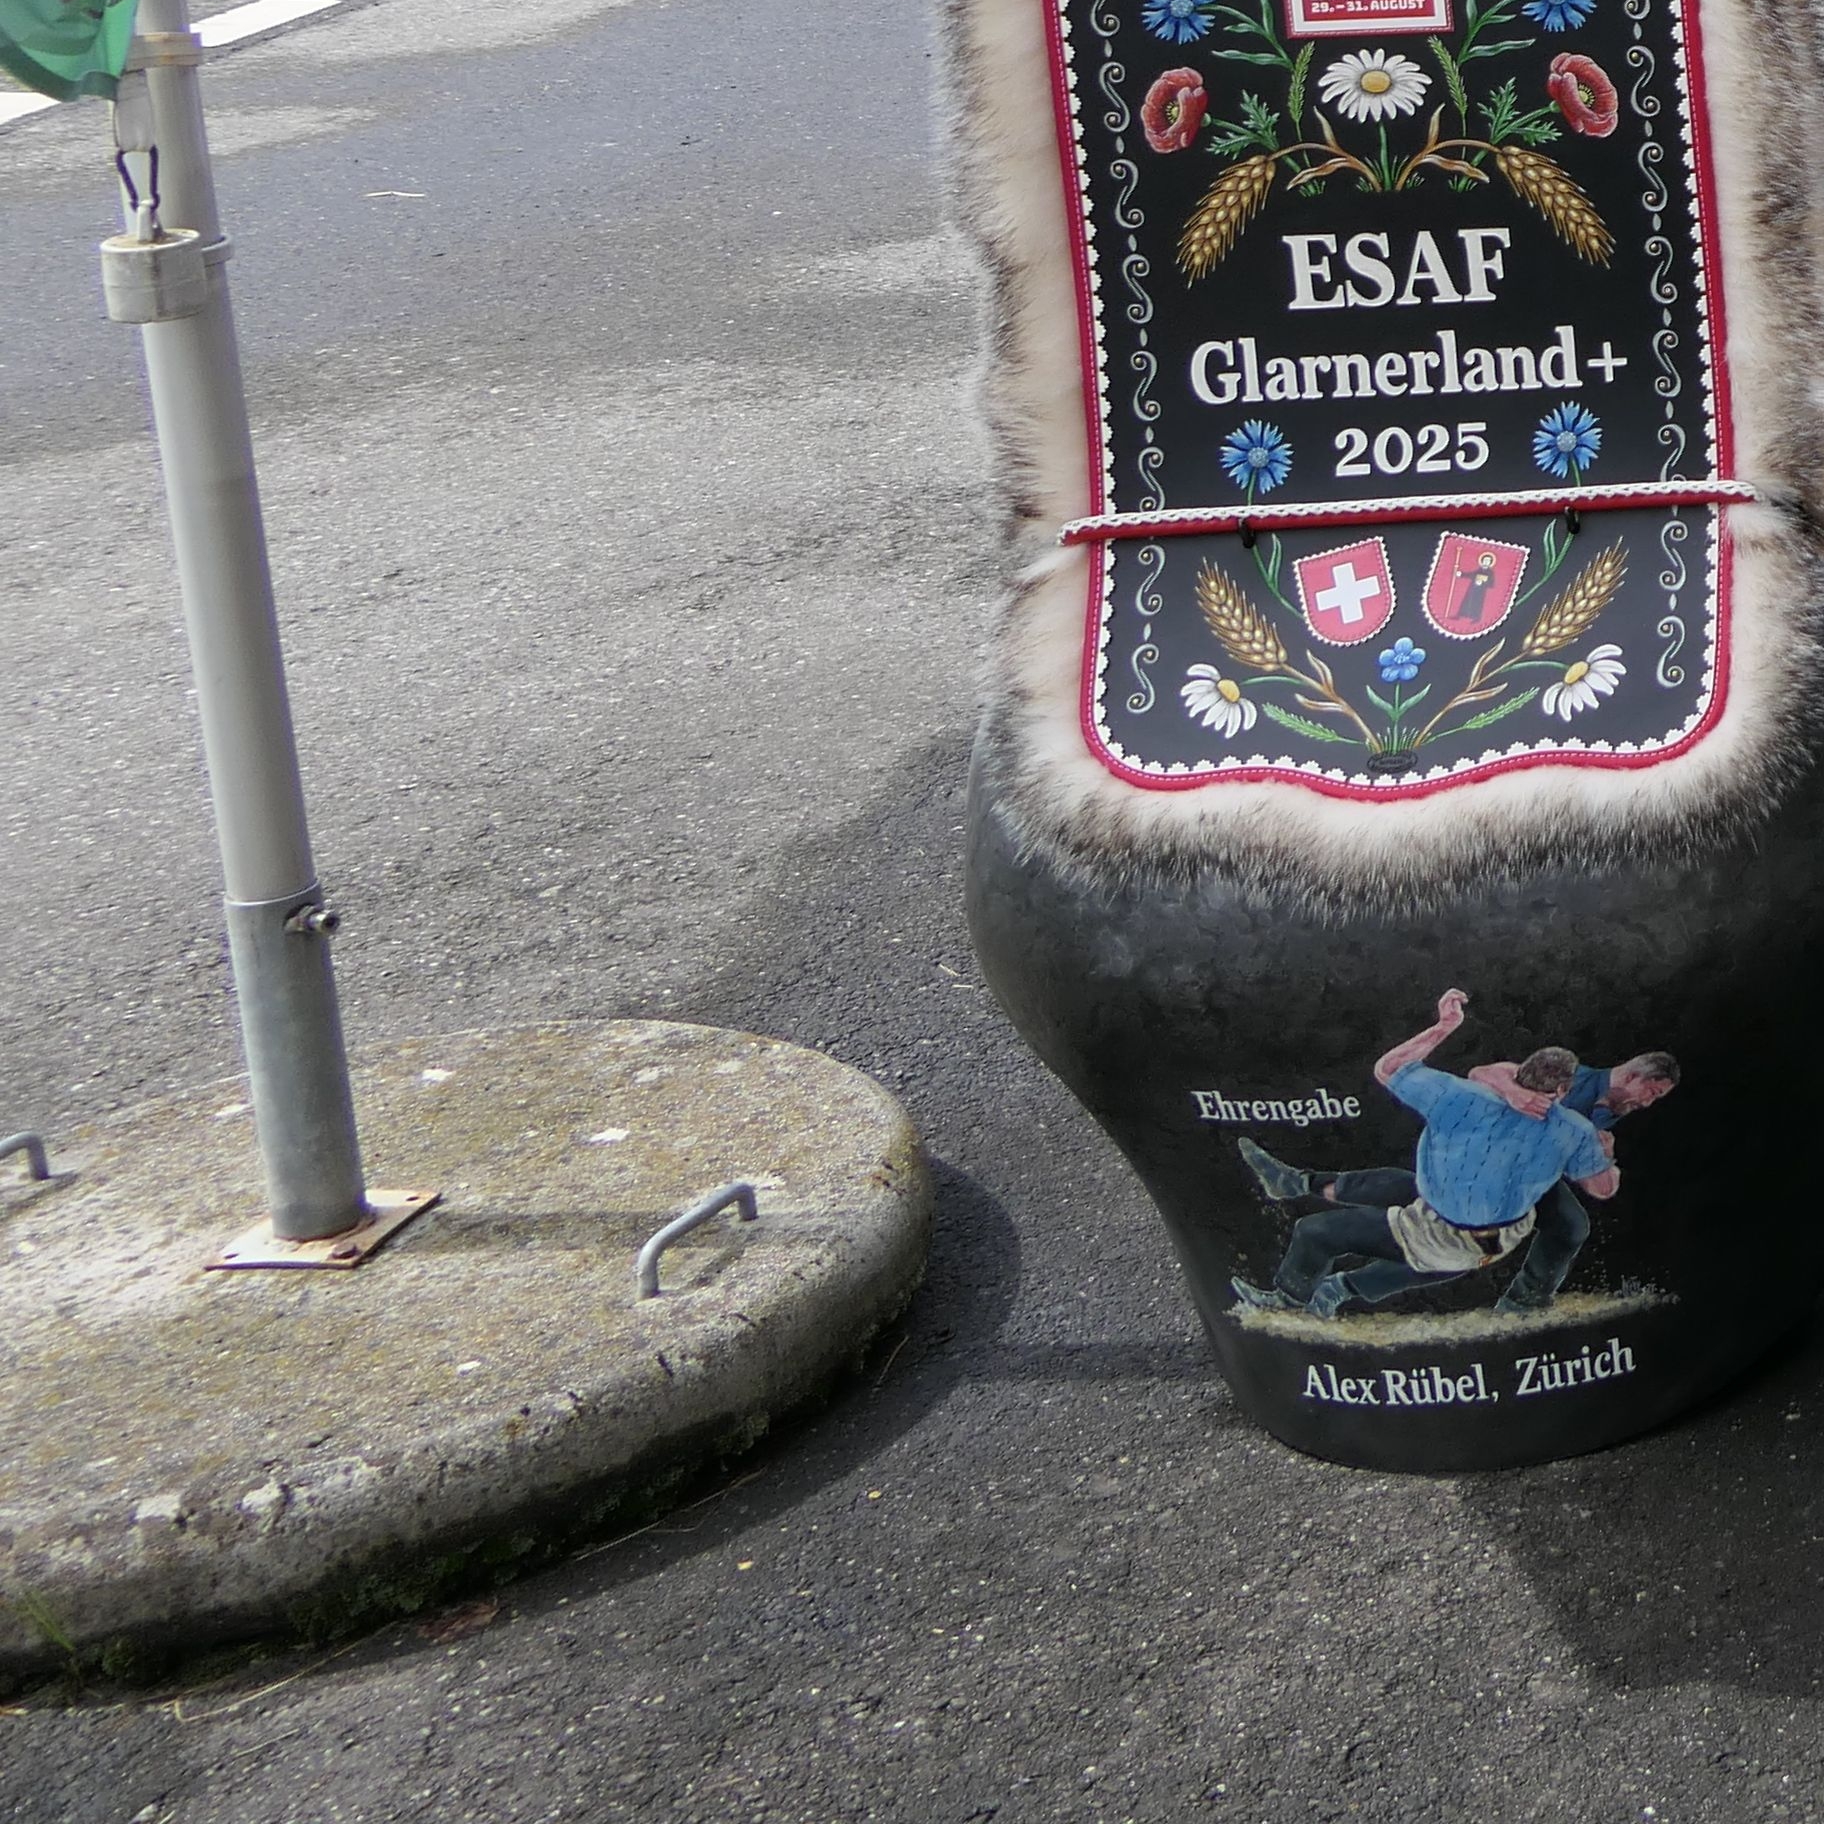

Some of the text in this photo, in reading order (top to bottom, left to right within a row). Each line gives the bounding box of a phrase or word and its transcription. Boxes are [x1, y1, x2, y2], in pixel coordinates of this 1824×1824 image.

[1283, 227, 1511, 312] ESAF
[1334, 421, 1491, 477] 2025
[1190, 1087, 1361, 1127] Ehrengabe
[1302, 1338, 1637, 1406] Alex Rübel, Zürich
